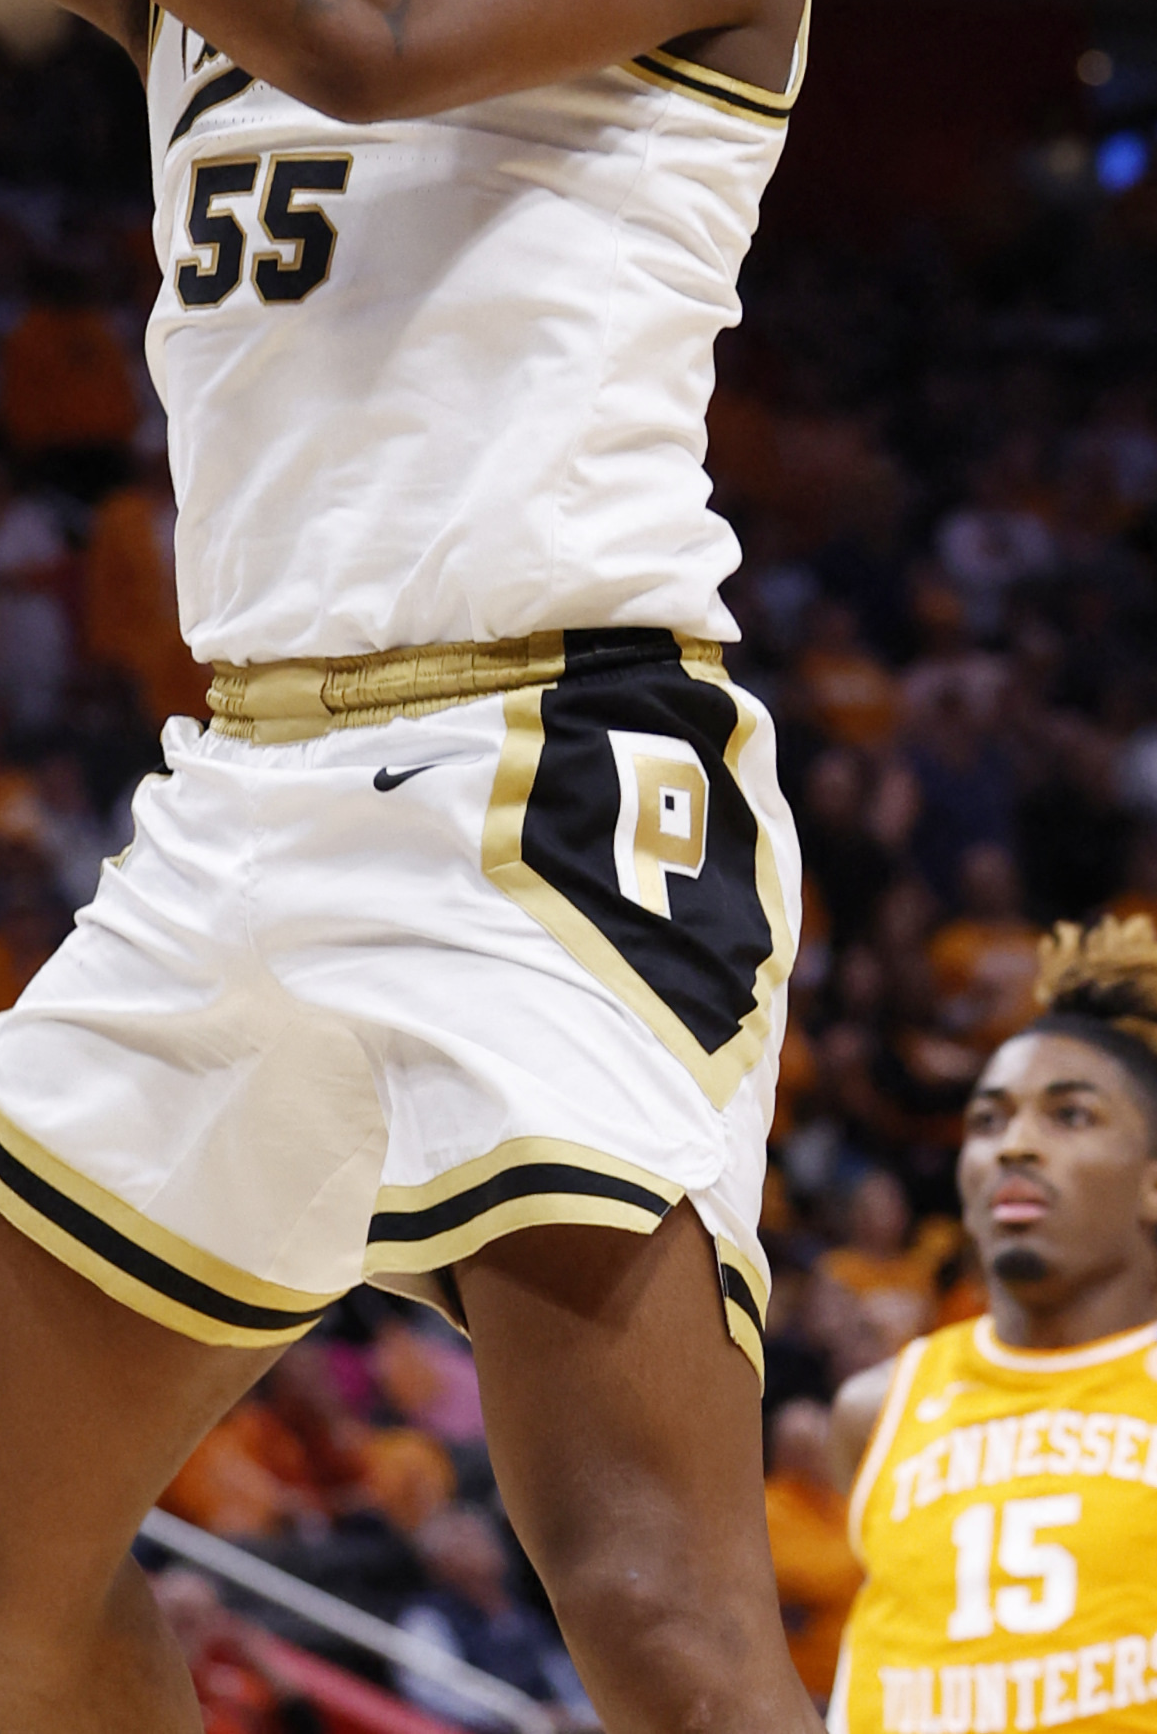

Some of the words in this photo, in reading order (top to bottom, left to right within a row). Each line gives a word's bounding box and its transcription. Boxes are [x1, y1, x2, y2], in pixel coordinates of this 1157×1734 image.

[174, 152, 354, 310] 55
[607, 729, 710, 921] P
[949, 1494, 1081, 1640] 15
